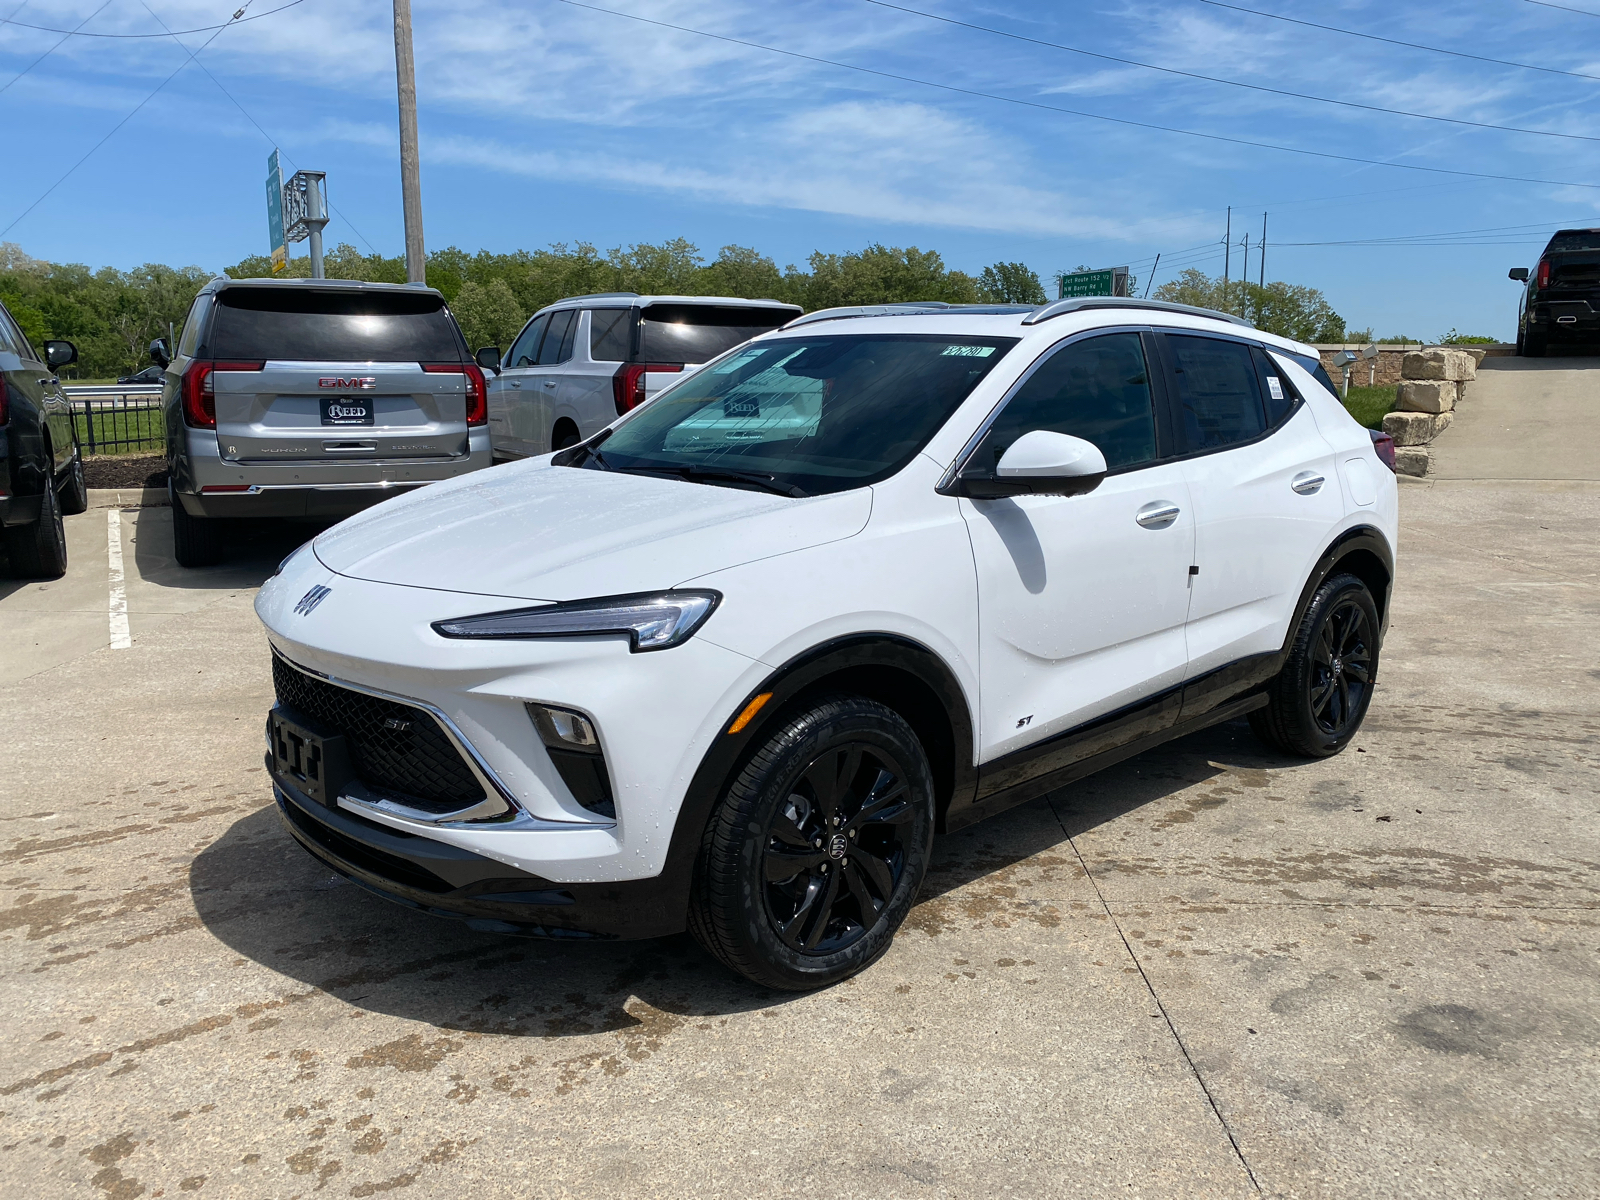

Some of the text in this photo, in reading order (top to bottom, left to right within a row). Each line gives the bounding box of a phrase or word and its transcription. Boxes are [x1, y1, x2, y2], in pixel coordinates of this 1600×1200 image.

[318, 377, 376, 389] GMC
[328, 404, 366, 419] REED
[384, 719, 410, 731] ST
[1015, 714, 1034, 729] ST
